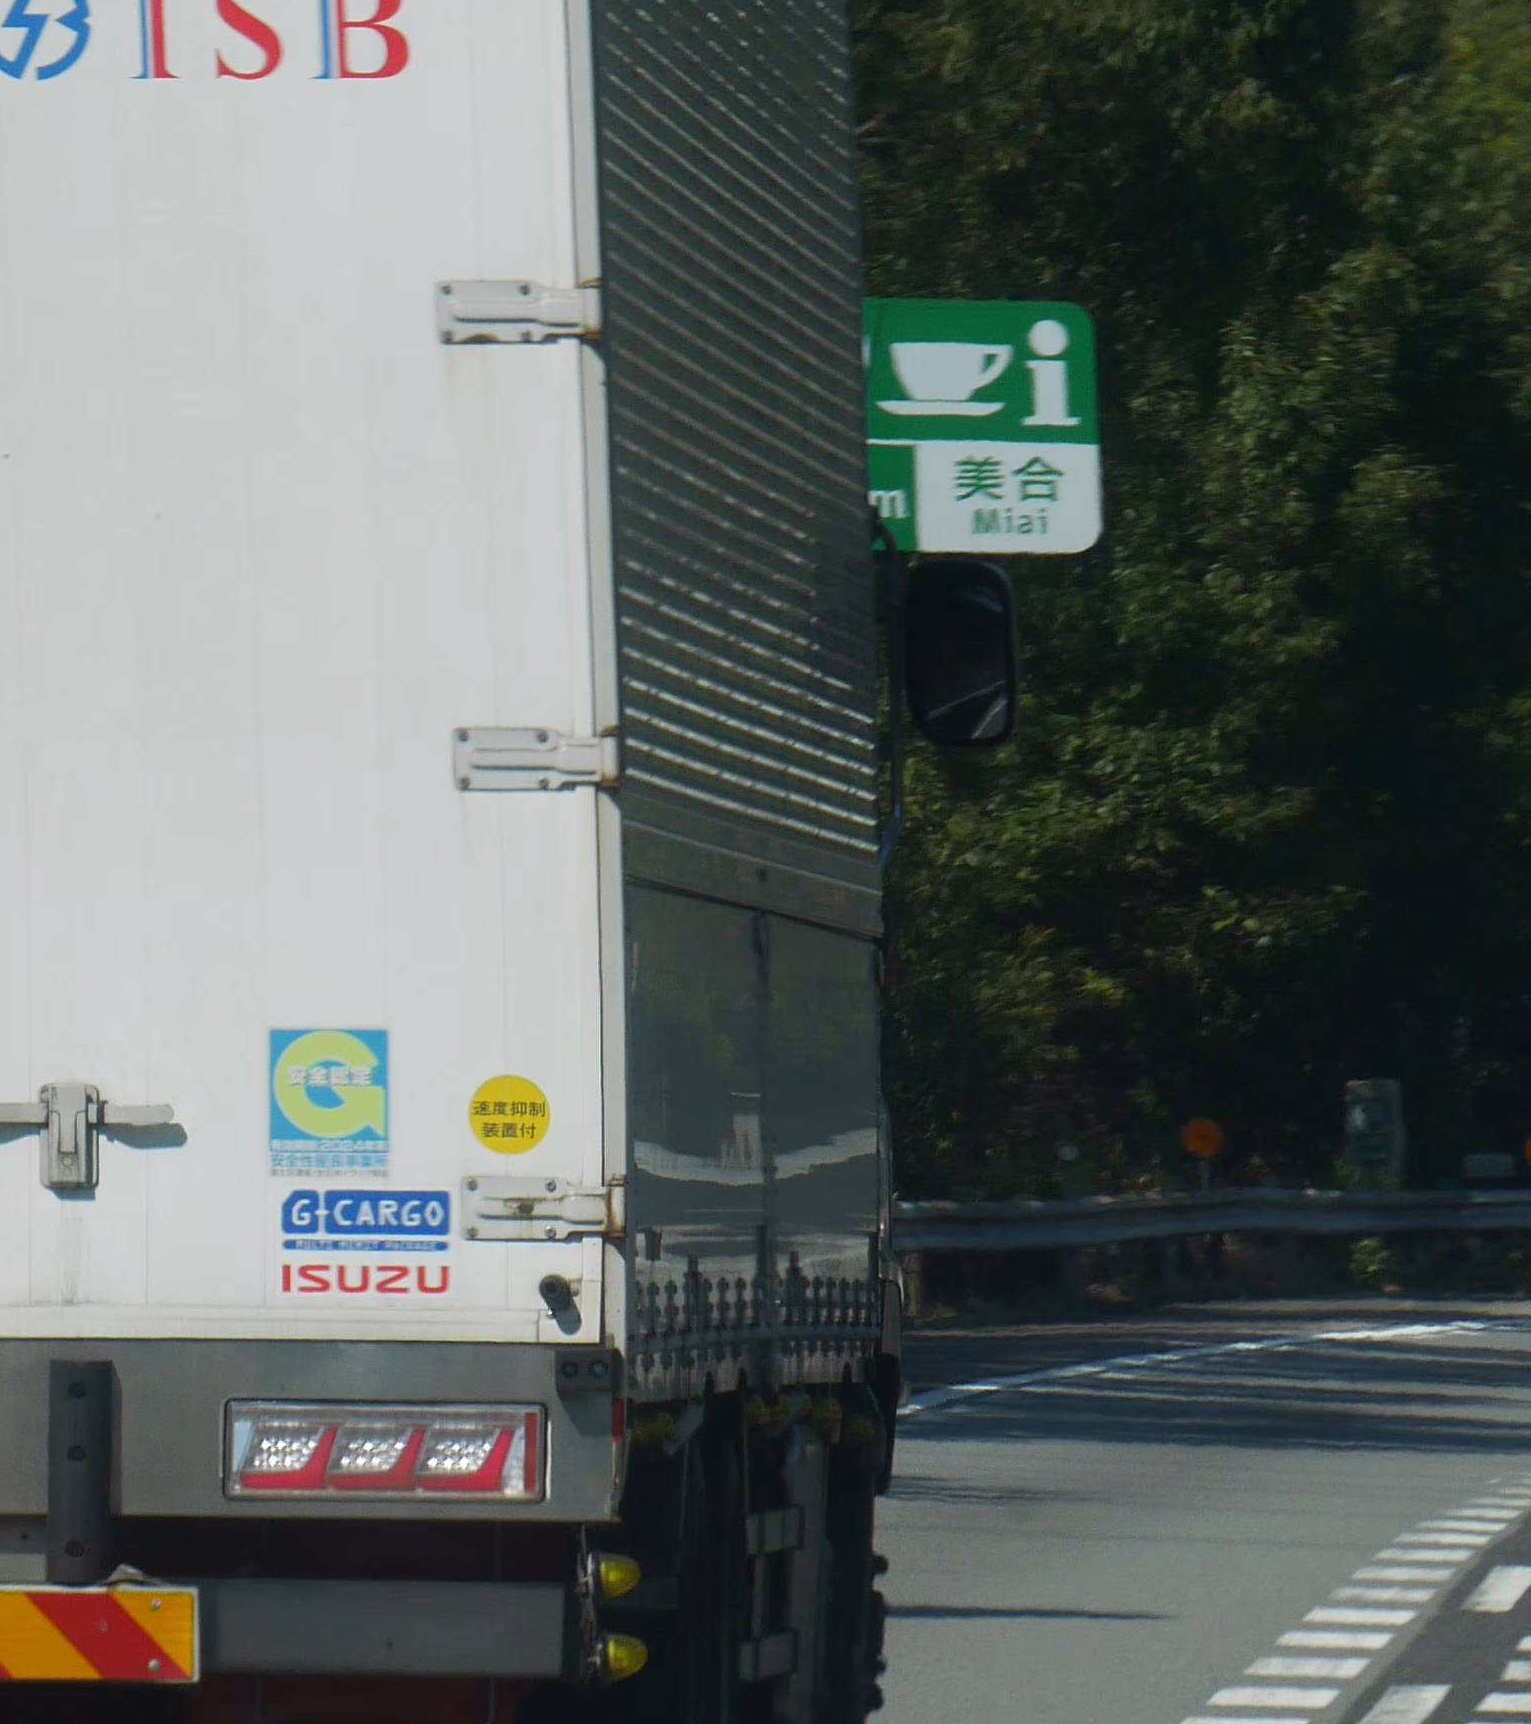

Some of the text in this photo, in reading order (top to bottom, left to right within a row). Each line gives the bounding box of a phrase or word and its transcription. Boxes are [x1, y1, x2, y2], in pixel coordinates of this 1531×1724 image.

[952, 454, 1066, 503] 美合
[971, 507, 1049, 535] Miai
[472, 1100, 547, 1119] 速度抑制
[482, 1122, 539, 1140] 装置付
[291, 1198, 445, 1228] G-CARGO
[280, 1263, 452, 1295] ISUZU
